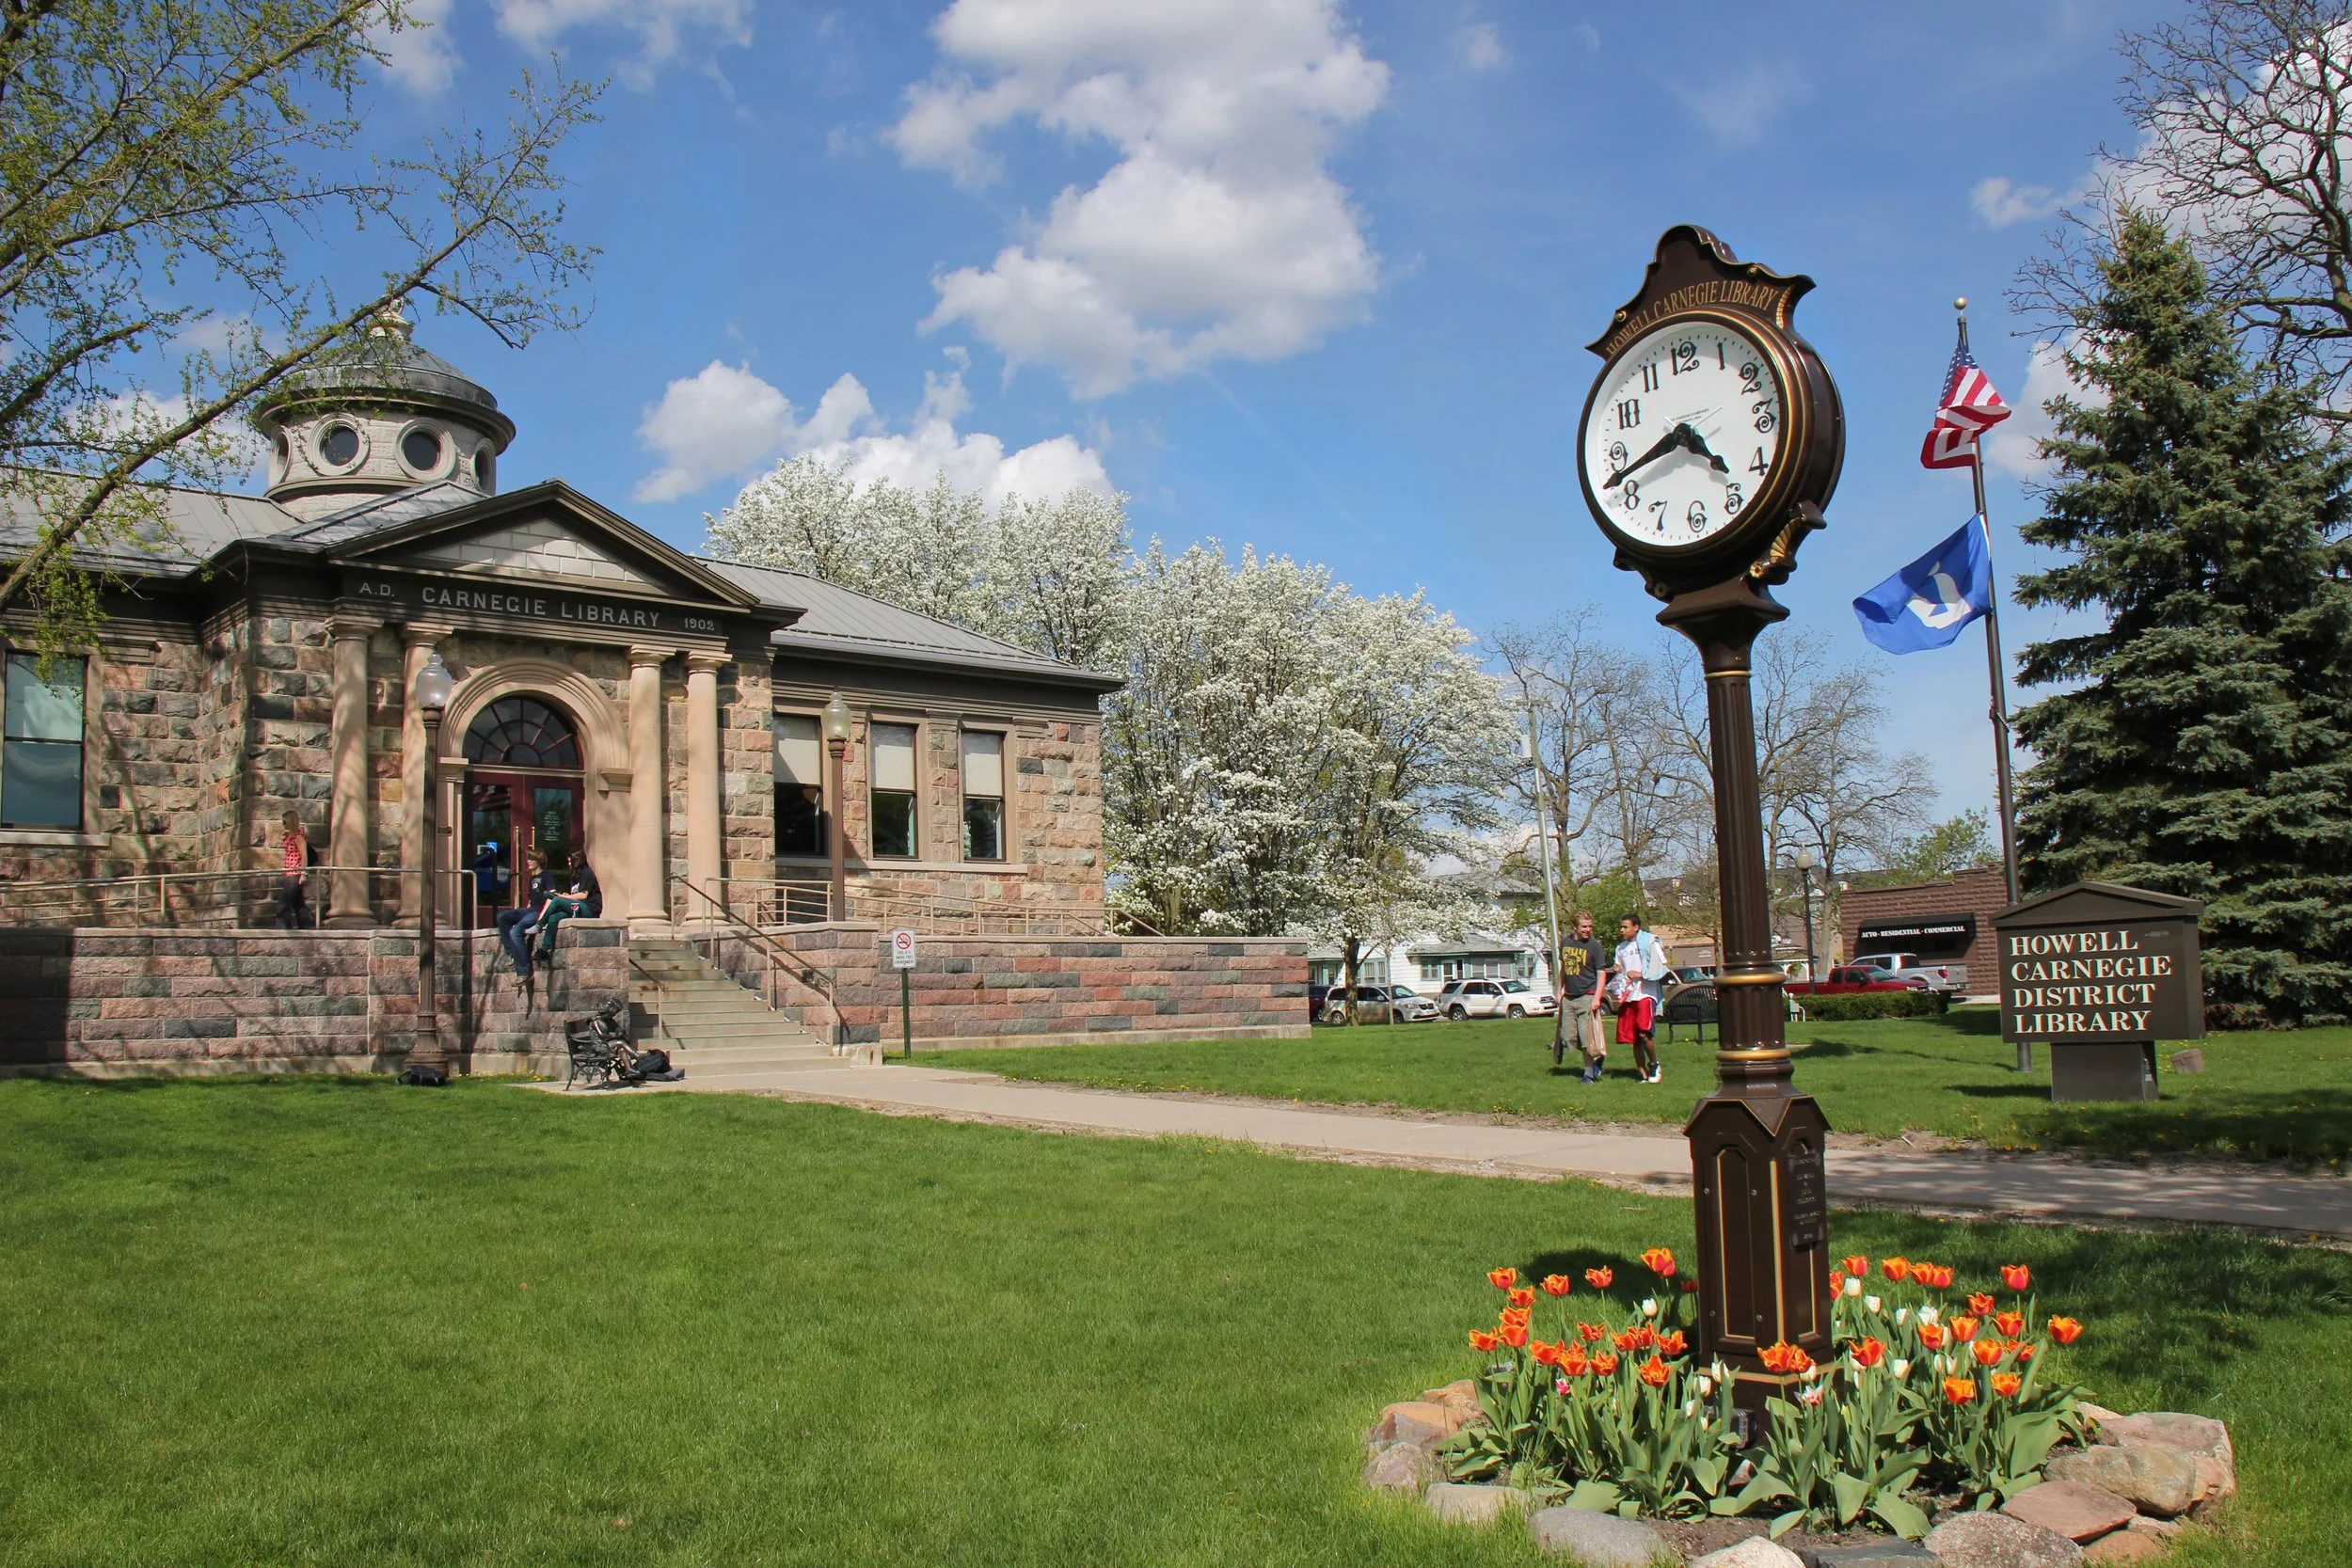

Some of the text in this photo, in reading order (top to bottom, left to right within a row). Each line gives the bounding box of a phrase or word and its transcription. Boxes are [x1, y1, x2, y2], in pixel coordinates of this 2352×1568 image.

[1653, 281, 1719, 319] CARNEGIE
[1719, 280, 1779, 311] LIBRARY
[1670, 341, 1700, 376] 12
[1717, 341, 1726, 371] 1
[1642, 362, 1659, 393] 11
[1739, 361, 1762, 395] 2
[1617, 398, 1642, 430] 10
[1752, 398, 1776, 434] 3
[1609, 441, 1629, 471] 9
[1748, 446, 1769, 477] 4
[1623, 480, 1641, 510] 8
[1724, 483, 1744, 515] 5
[1648, 500, 1668, 531] 7
[1686, 499, 1708, 532] 6
[358, 581, 395, 597] A.D.
[421, 586, 660, 628] CARNEGIE LIBRARY
[683, 617, 715, 631] 1902
[1881, 927, 1921, 937] RESIDENTIAL
[1924, 926, 1965, 934] COMMERCIAL
[2010, 930, 2139, 957] HOWELL
[2010, 955, 2173, 982] CARNEGIE
[2013, 983, 2156, 1008] DISTRICT
[2014, 1010, 2152, 1034] LIBRARY
